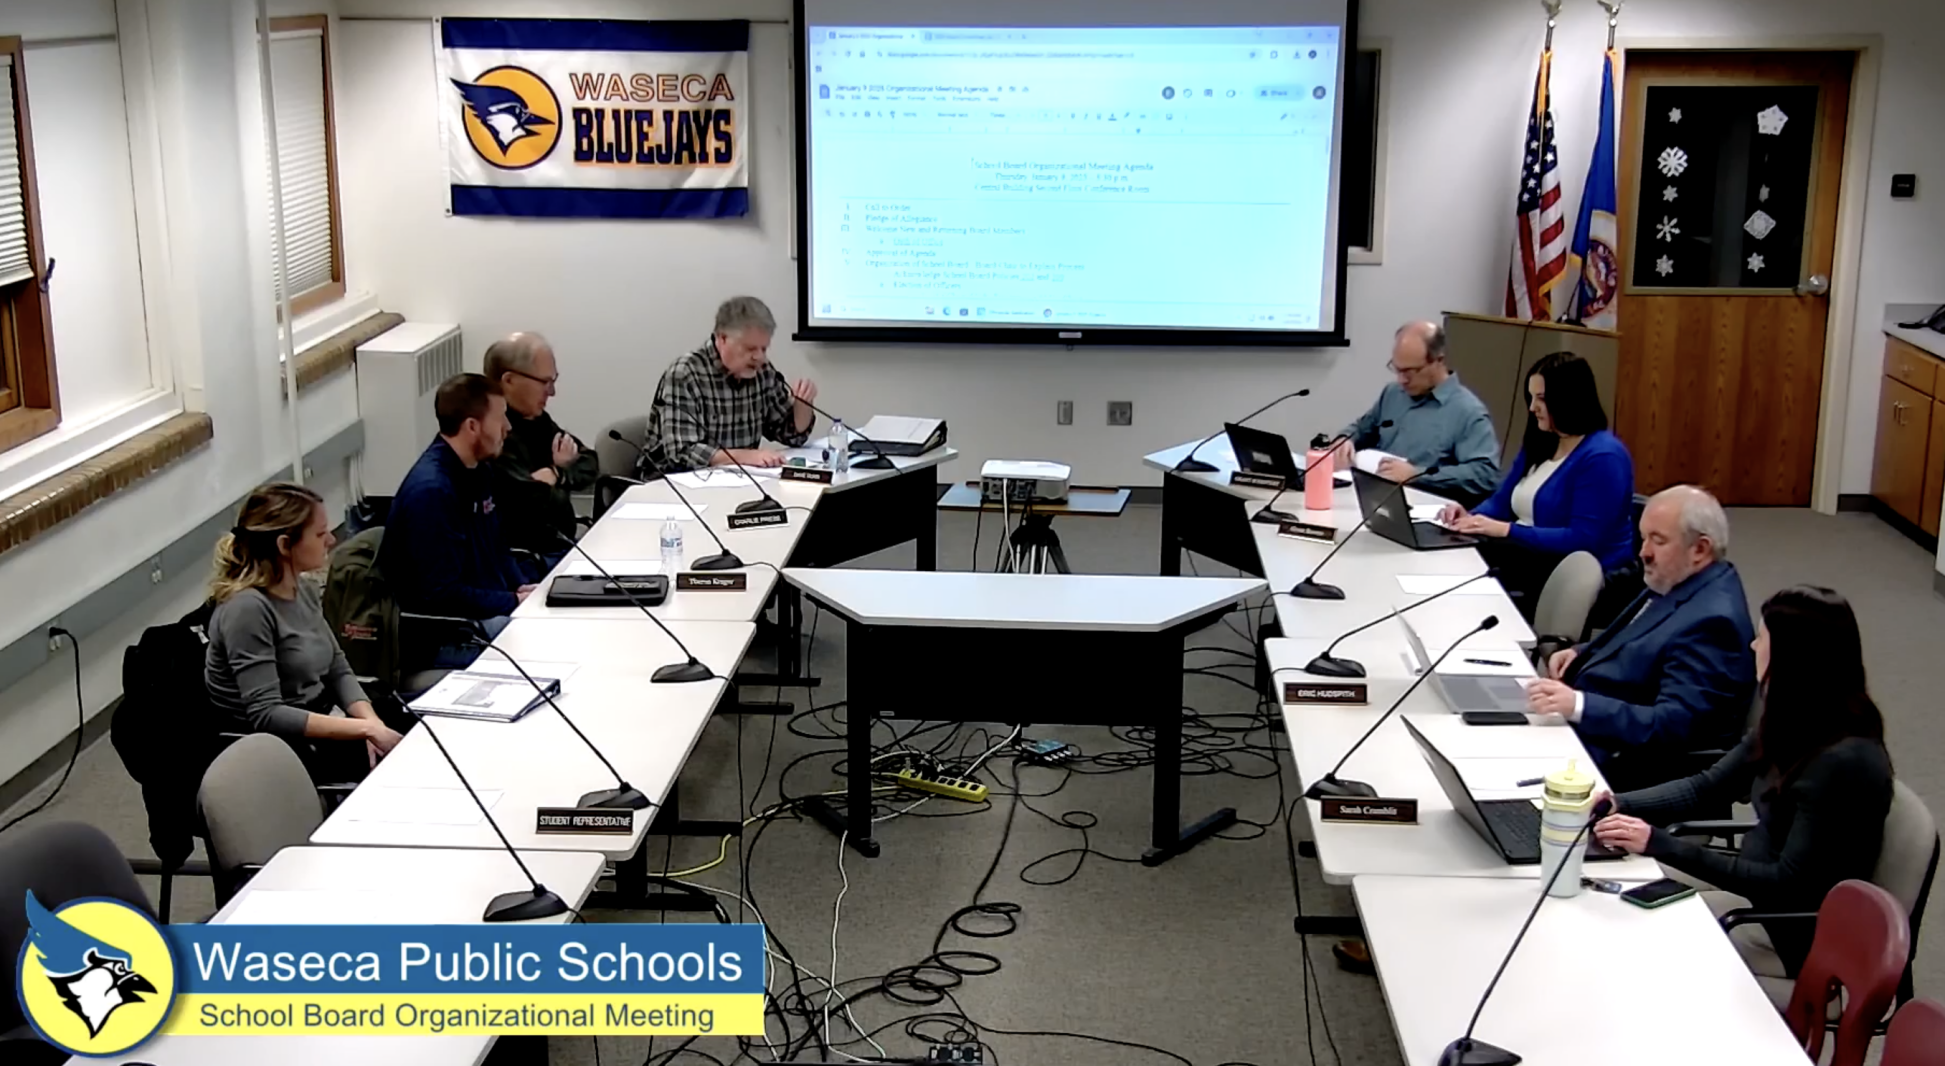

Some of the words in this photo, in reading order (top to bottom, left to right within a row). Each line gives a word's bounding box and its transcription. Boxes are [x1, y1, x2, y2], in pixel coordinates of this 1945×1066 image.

[569, 72, 735, 103] WASECA
[572, 107, 734, 165] BLUEJAYS
[1003, 161, 1027, 169] Board
[1029, 161, 1086, 171] Organizational
[1088, 162, 1121, 172] Meeting
[1123, 162, 1154, 172] Agenda
[1297, 689, 1316, 697] ERIC
[1339, 805, 1362, 814] Sarah
[540, 815, 571, 826] STUDENT
[572, 816, 631, 827] REPRESENTATIVE
